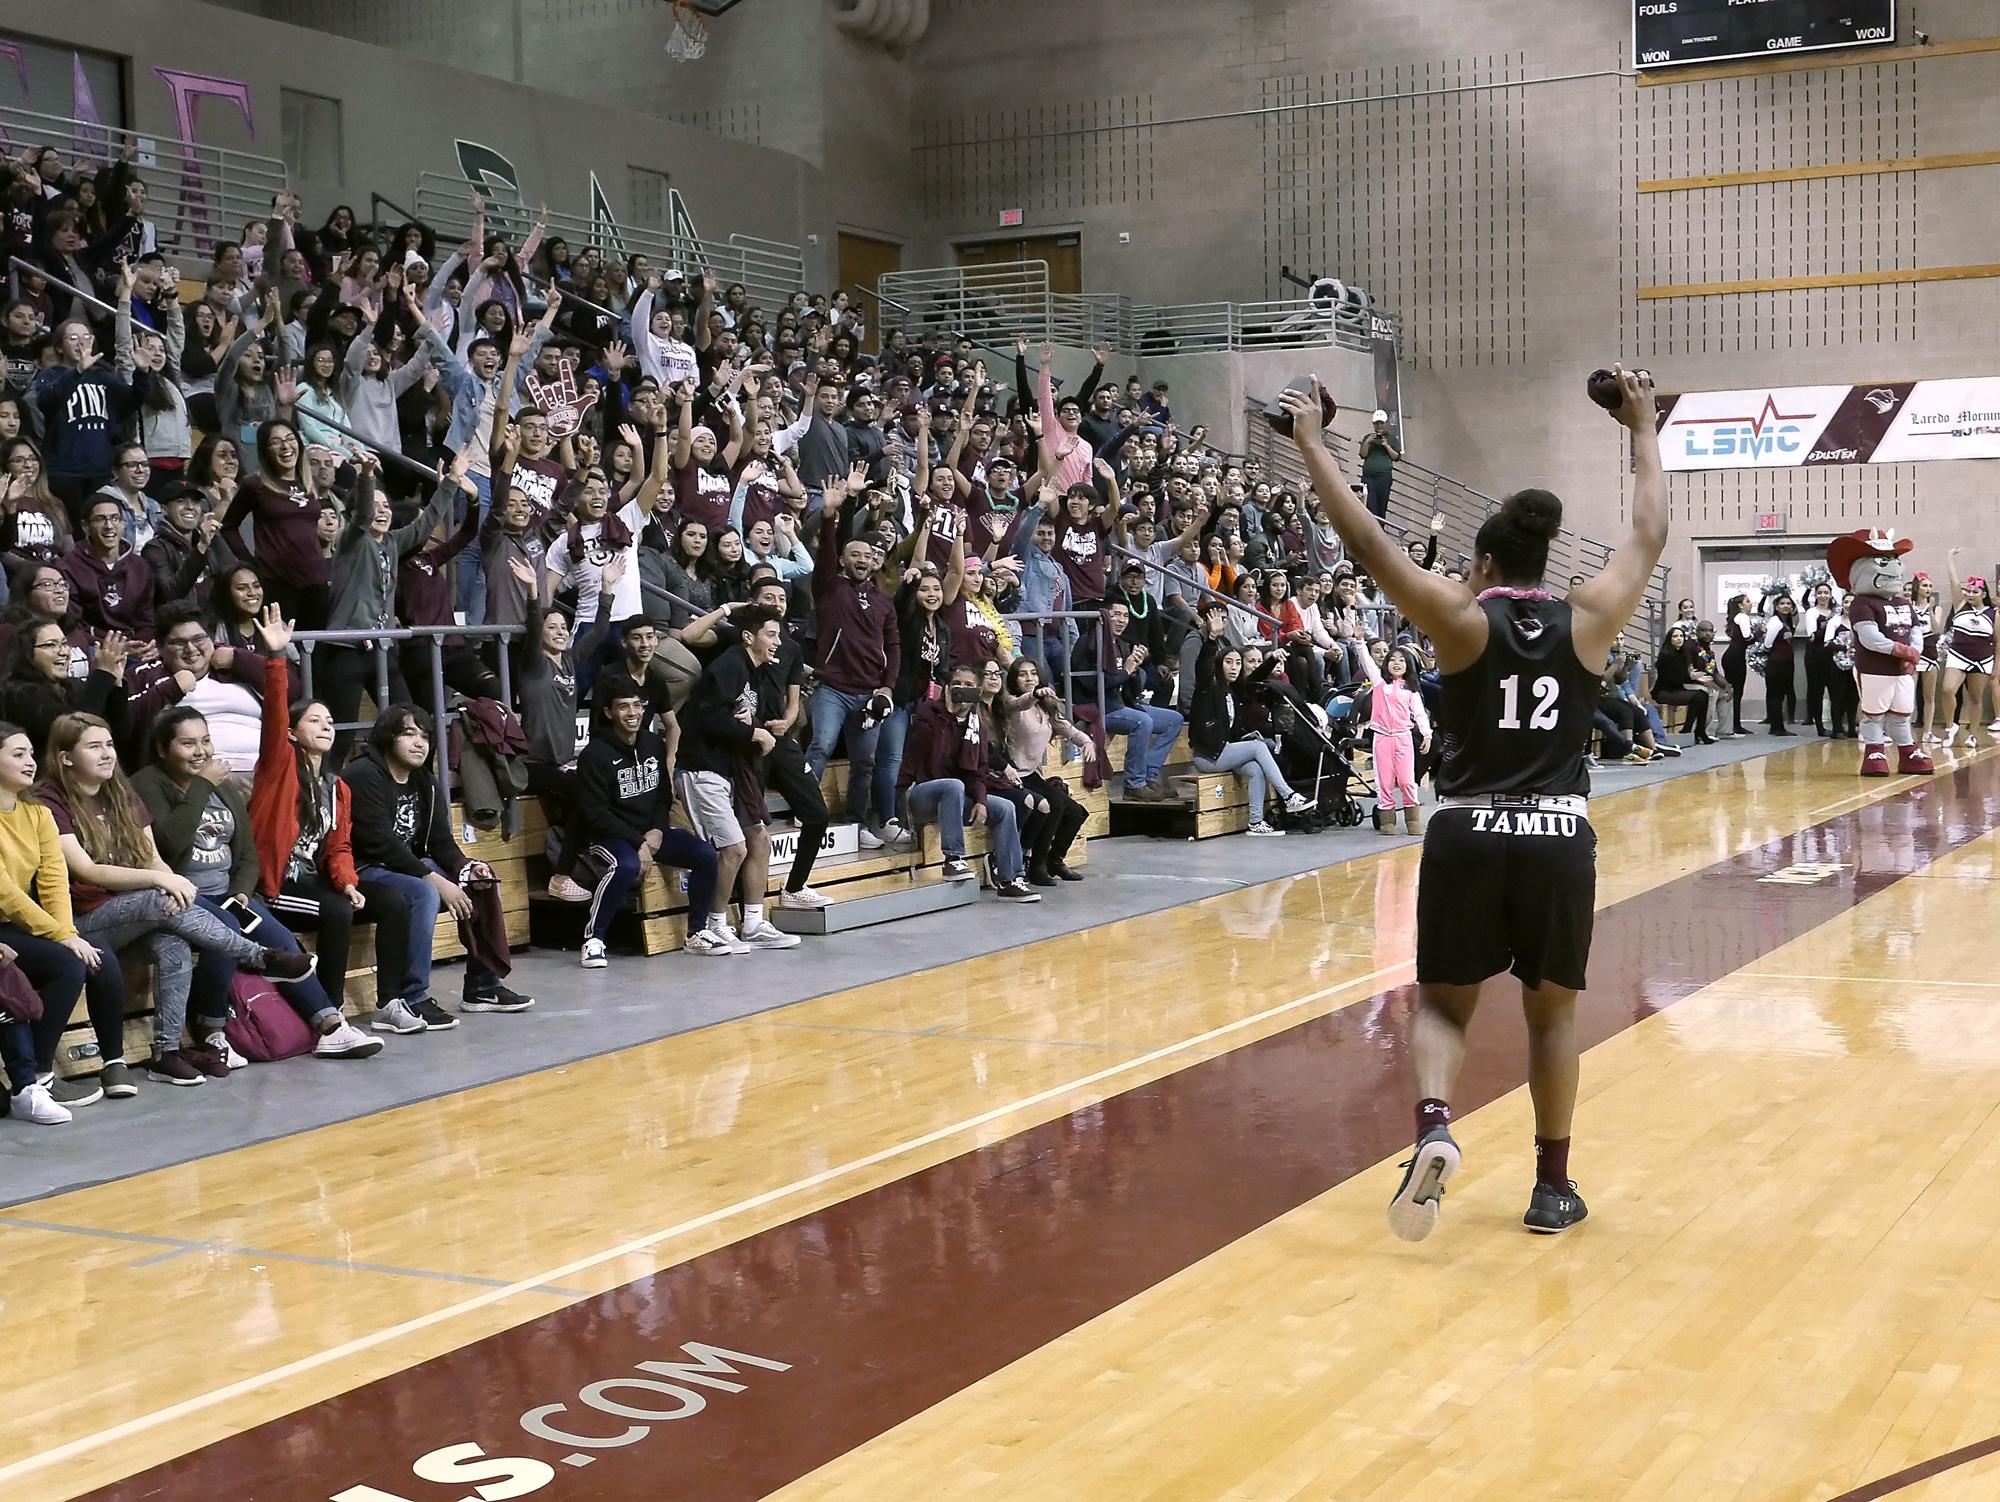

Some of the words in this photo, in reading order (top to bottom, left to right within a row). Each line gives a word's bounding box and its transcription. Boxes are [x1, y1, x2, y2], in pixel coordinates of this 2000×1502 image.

[1639, 3, 1677, 16] FOULS
[1855, 27, 1886, 39] WON
[1766, 37, 1802, 49] GAME
[1641, 50, 1670, 62] WON
[1911, 413, 1950, 425] Laredo
[1685, 426, 1800, 461] LSMC
[1498, 674, 1560, 731] 12
[1472, 809, 1578, 838] TAMIU
